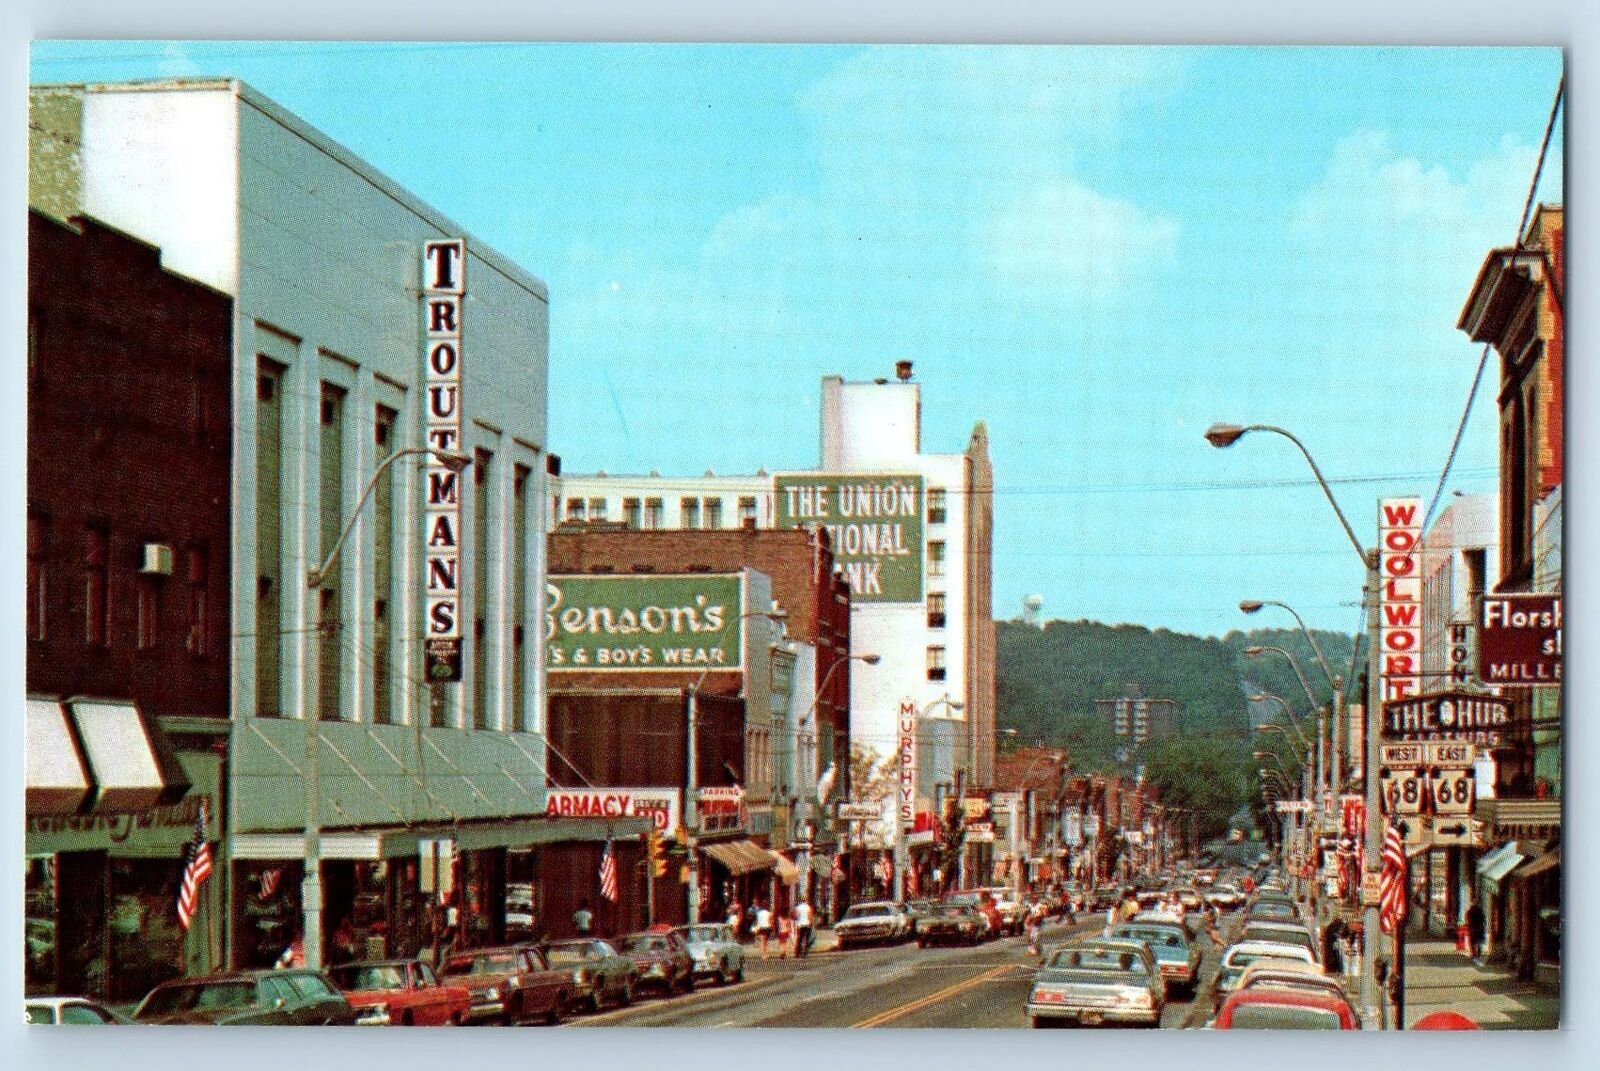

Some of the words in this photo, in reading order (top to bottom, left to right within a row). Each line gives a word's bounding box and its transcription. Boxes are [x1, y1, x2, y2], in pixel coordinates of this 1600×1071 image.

[426, 243, 459, 634] TROUTMANS
[785, 485, 829, 517] THE
[839, 484, 916, 517] UNION
[1384, 505, 1417, 700] WOOLWORT
[572, 648, 587, 664] &
[596, 645, 652, 664] BOY'S
[662, 647, 724, 664] WEAR
[1388, 703, 1438, 730] THE
[1386, 747, 1417, 760] WEST
[1437, 747, 1466, 760] EAST
[1387, 779, 1417, 803] 68
[1437, 778, 1467, 803] 68
